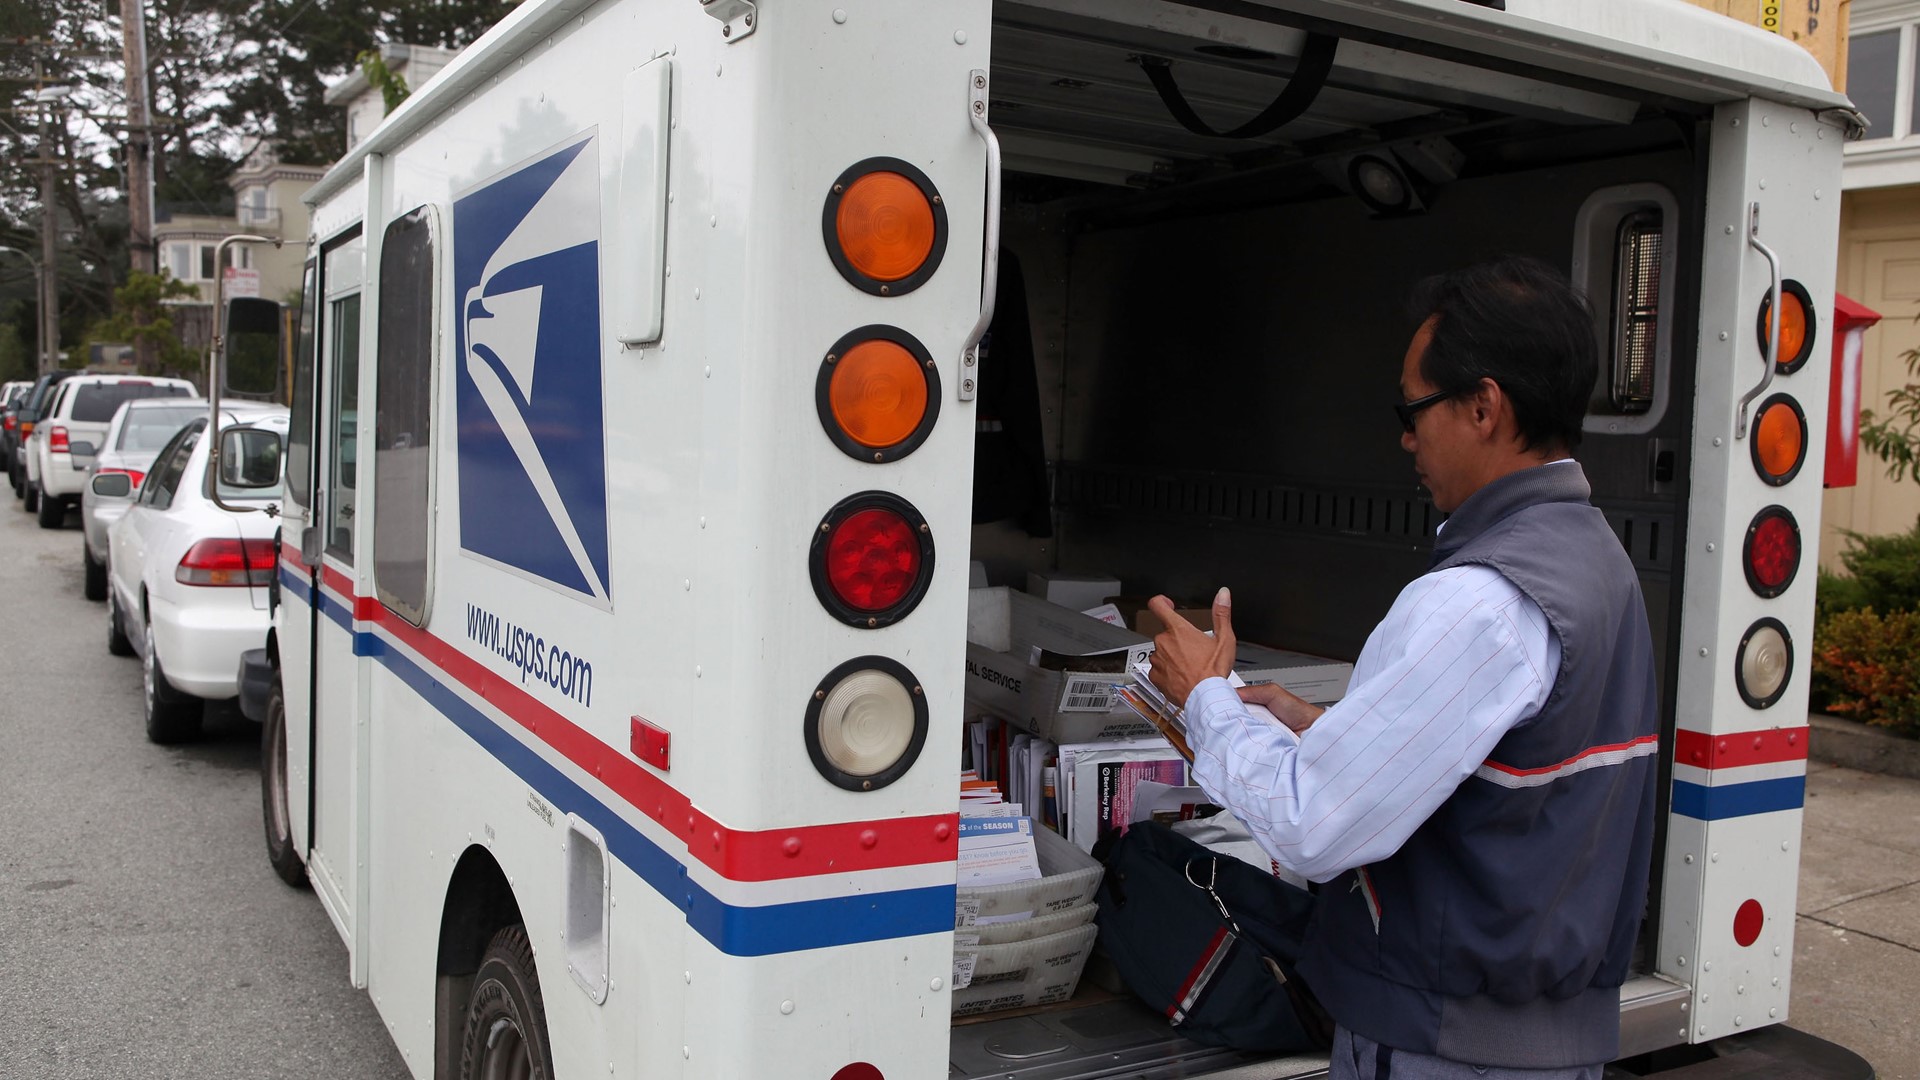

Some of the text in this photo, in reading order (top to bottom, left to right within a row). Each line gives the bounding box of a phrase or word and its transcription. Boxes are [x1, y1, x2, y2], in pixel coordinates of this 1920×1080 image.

[466, 602, 593, 708] www.usps.com
[981, 666, 1022, 694] SERVICE
[1102, 776, 1110, 820] Berkeley Rep
[983, 822, 1014, 830] SEASON
[960, 994, 1025, 1008] UNITED STATES
